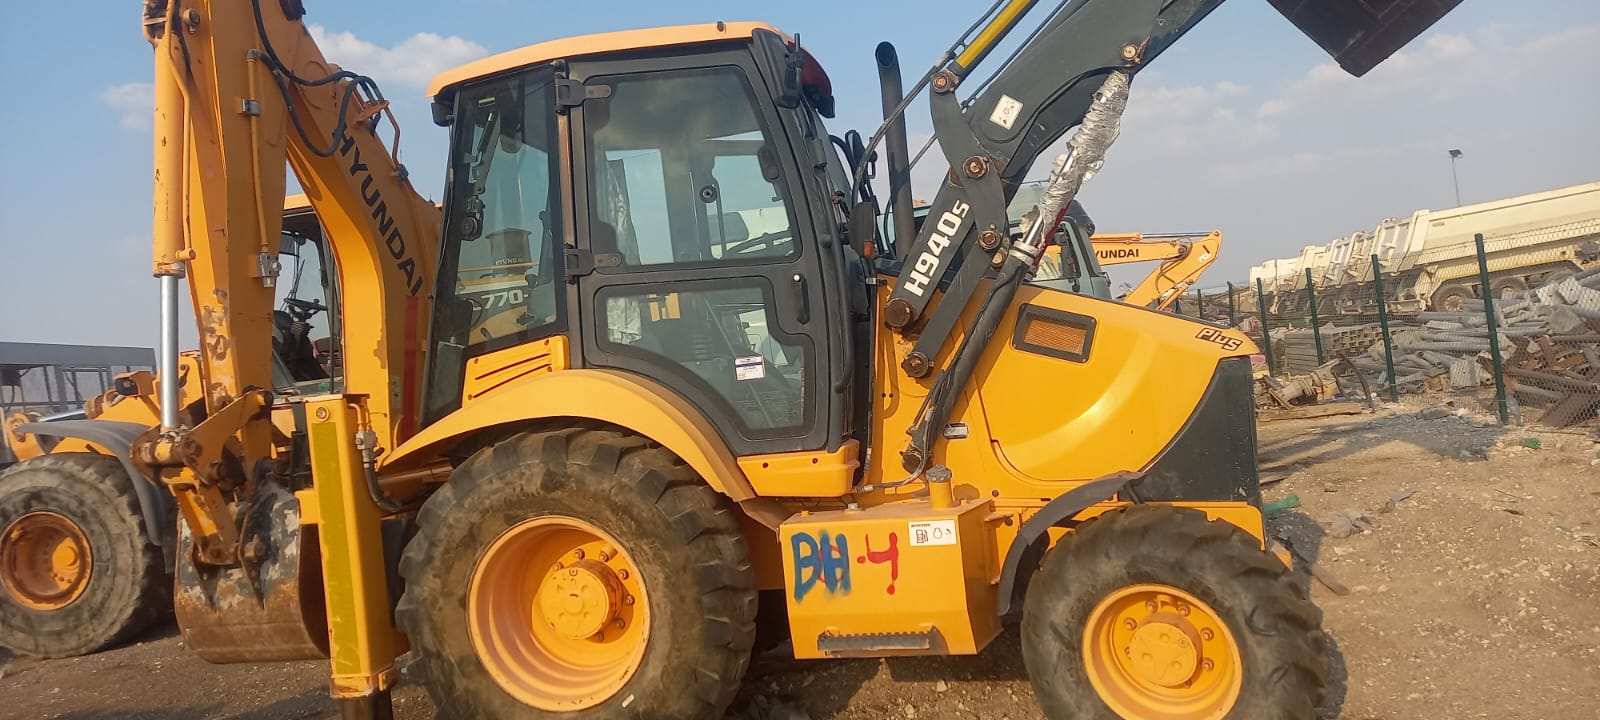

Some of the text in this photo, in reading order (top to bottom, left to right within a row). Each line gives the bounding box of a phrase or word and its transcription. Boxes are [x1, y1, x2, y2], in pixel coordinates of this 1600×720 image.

[338, 124, 424, 296] HYUNDAI
[1095, 249, 1139, 259] YUNDAI
[1195, 327, 1243, 351] Plus
